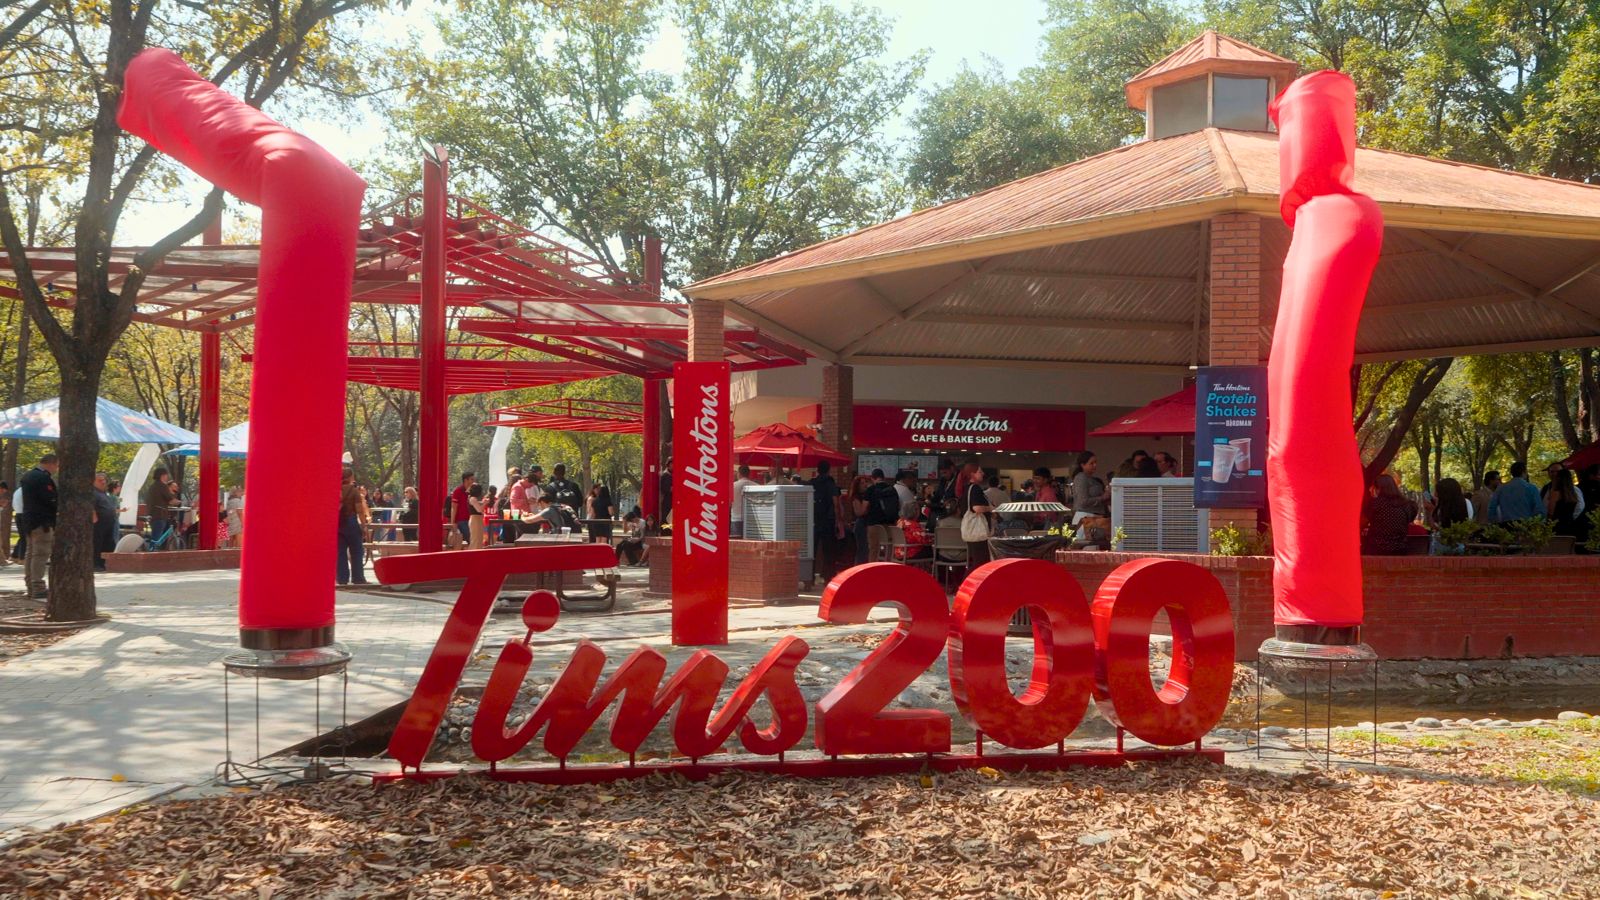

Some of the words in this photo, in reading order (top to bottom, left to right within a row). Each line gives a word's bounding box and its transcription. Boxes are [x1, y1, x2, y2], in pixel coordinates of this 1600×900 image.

[1207, 392, 1257, 404] Protein
[902, 408, 935, 430] Tim
[940, 408, 1008, 431] Hortons
[1206, 405, 1257, 417] Shakes
[683, 384, 719, 497] Hortons
[911, 434, 938, 443] CAFE
[938, 434, 946, 443] &
[947, 435, 974, 443] BAKE
[975, 436, 1002, 444] SHOP
[683, 502, 718, 555] Tim
